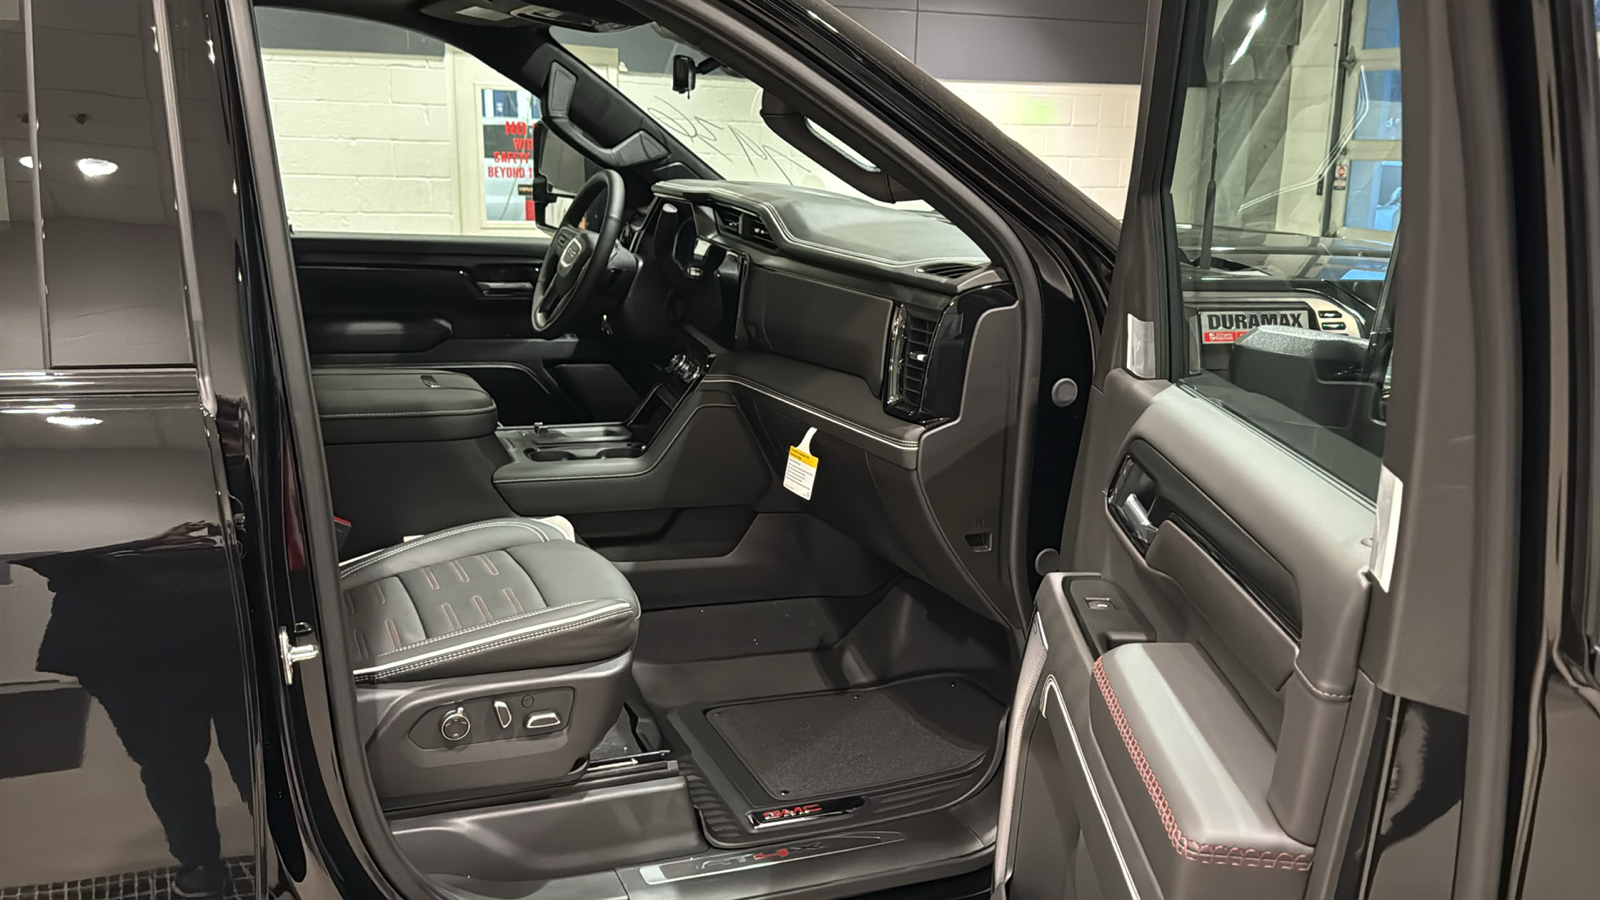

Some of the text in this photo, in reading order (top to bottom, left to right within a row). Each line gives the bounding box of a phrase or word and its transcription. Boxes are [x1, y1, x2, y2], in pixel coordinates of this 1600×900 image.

[505, 120, 527, 136] NO
[493, 151, 530, 164] SAFETY
[487, 166, 526, 179] BEYOND
[1207, 313, 1303, 330] DURAMAX
